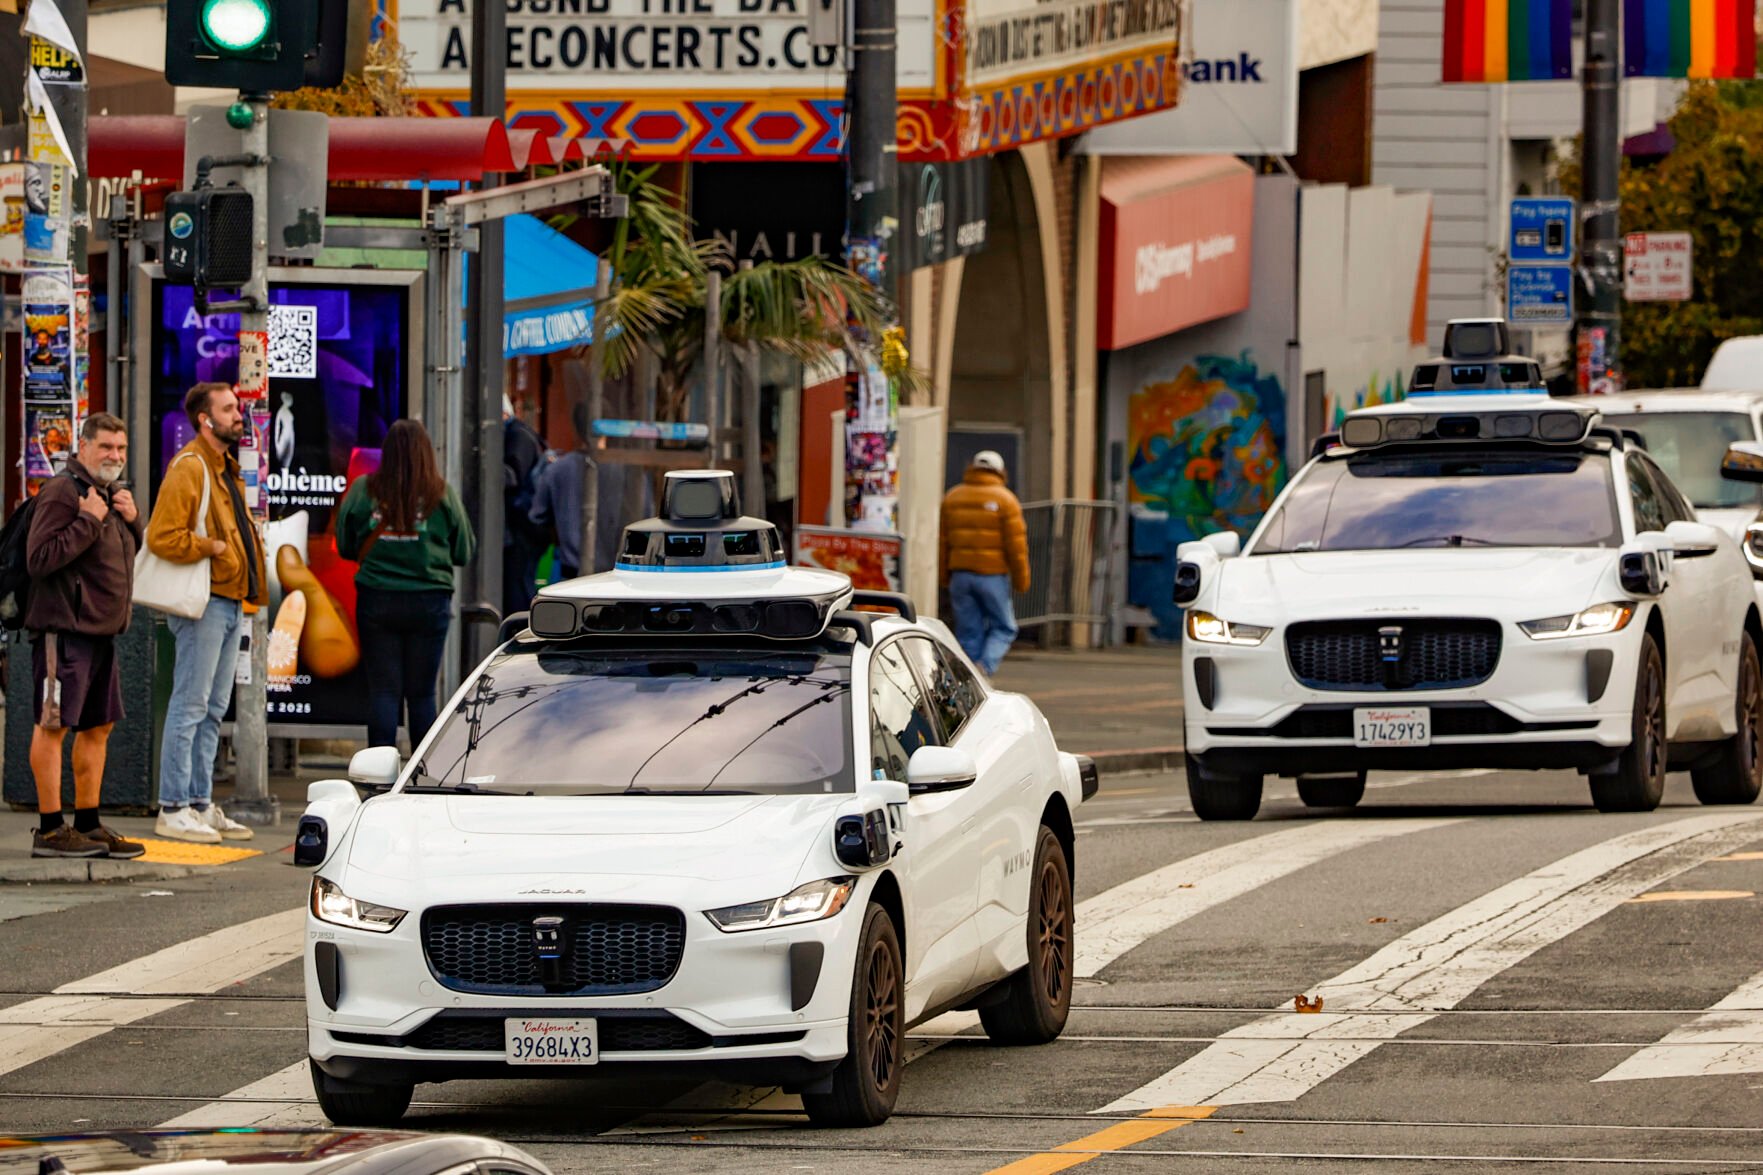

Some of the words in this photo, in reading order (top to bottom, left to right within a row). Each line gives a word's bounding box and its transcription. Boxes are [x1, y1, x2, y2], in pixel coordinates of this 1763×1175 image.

[32, 46, 79, 68] HELP
[1182, 51, 1263, 82] ank
[713, 229, 848, 258] NAIL
[290, 495, 335, 506] PUCCINI
[278, 701, 312, 714] 2025
[1360, 723, 1425, 741] 17429Y3
[1003, 849, 1031, 878] WAYMO
[524, 1021, 575, 1036] California
[512, 1036, 592, 1058] 39684X3
